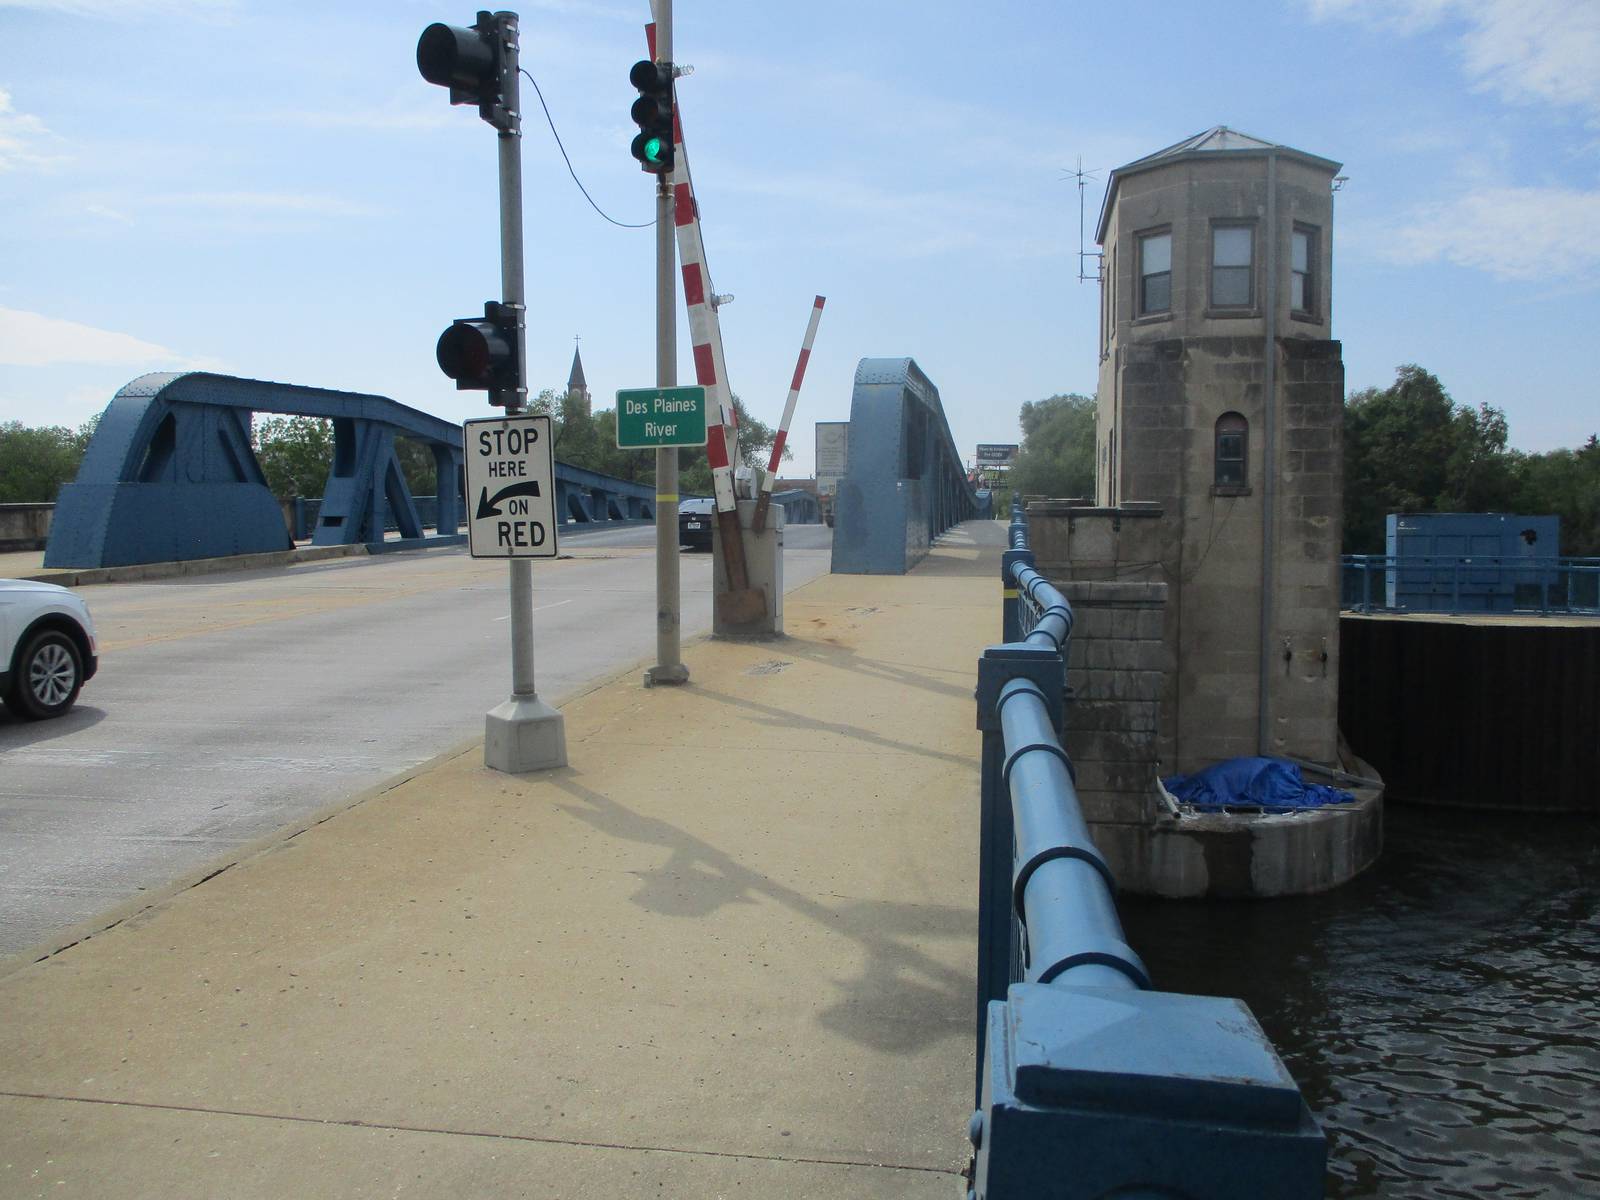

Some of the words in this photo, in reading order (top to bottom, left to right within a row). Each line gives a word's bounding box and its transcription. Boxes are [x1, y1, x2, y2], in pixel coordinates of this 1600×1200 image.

[626, 400, 648, 415] Des
[654, 397, 697, 413] Plaines
[645, 422, 677, 437] River
[479, 428, 539, 456] STOP
[488, 460, 527, 477] HERE
[509, 499, 528, 515] ON
[498, 521, 545, 547] RED
